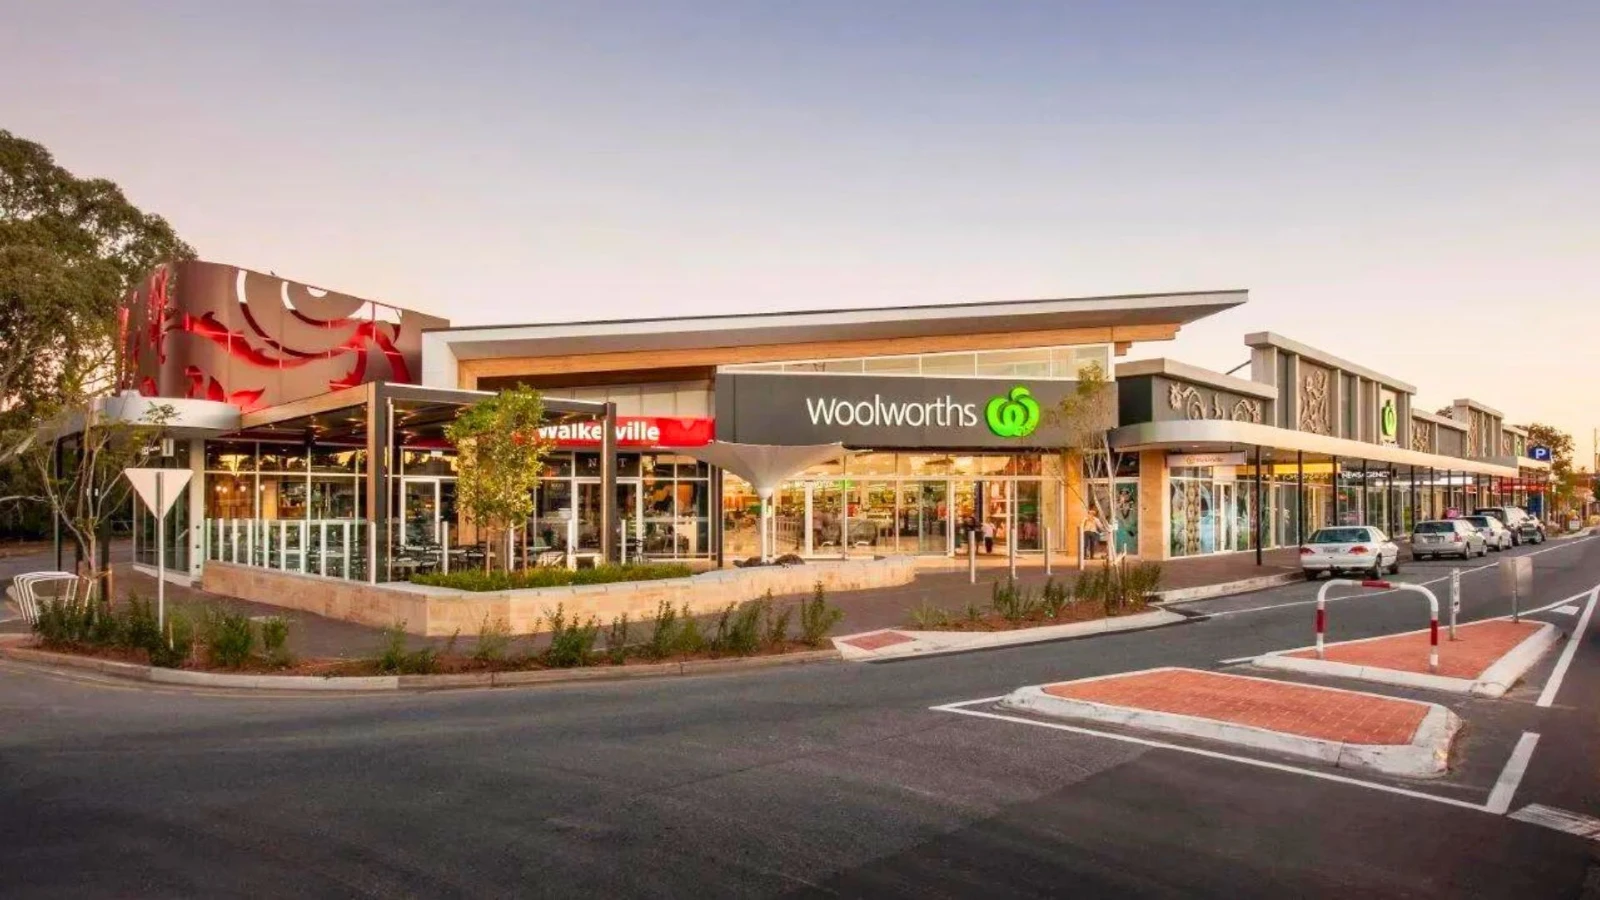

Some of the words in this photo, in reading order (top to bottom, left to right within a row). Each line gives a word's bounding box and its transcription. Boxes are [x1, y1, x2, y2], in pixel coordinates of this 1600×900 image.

[806, 394, 977, 427] Woolworths
[538, 421, 660, 441] walkeville
[1535, 448, 1547, 459] P
